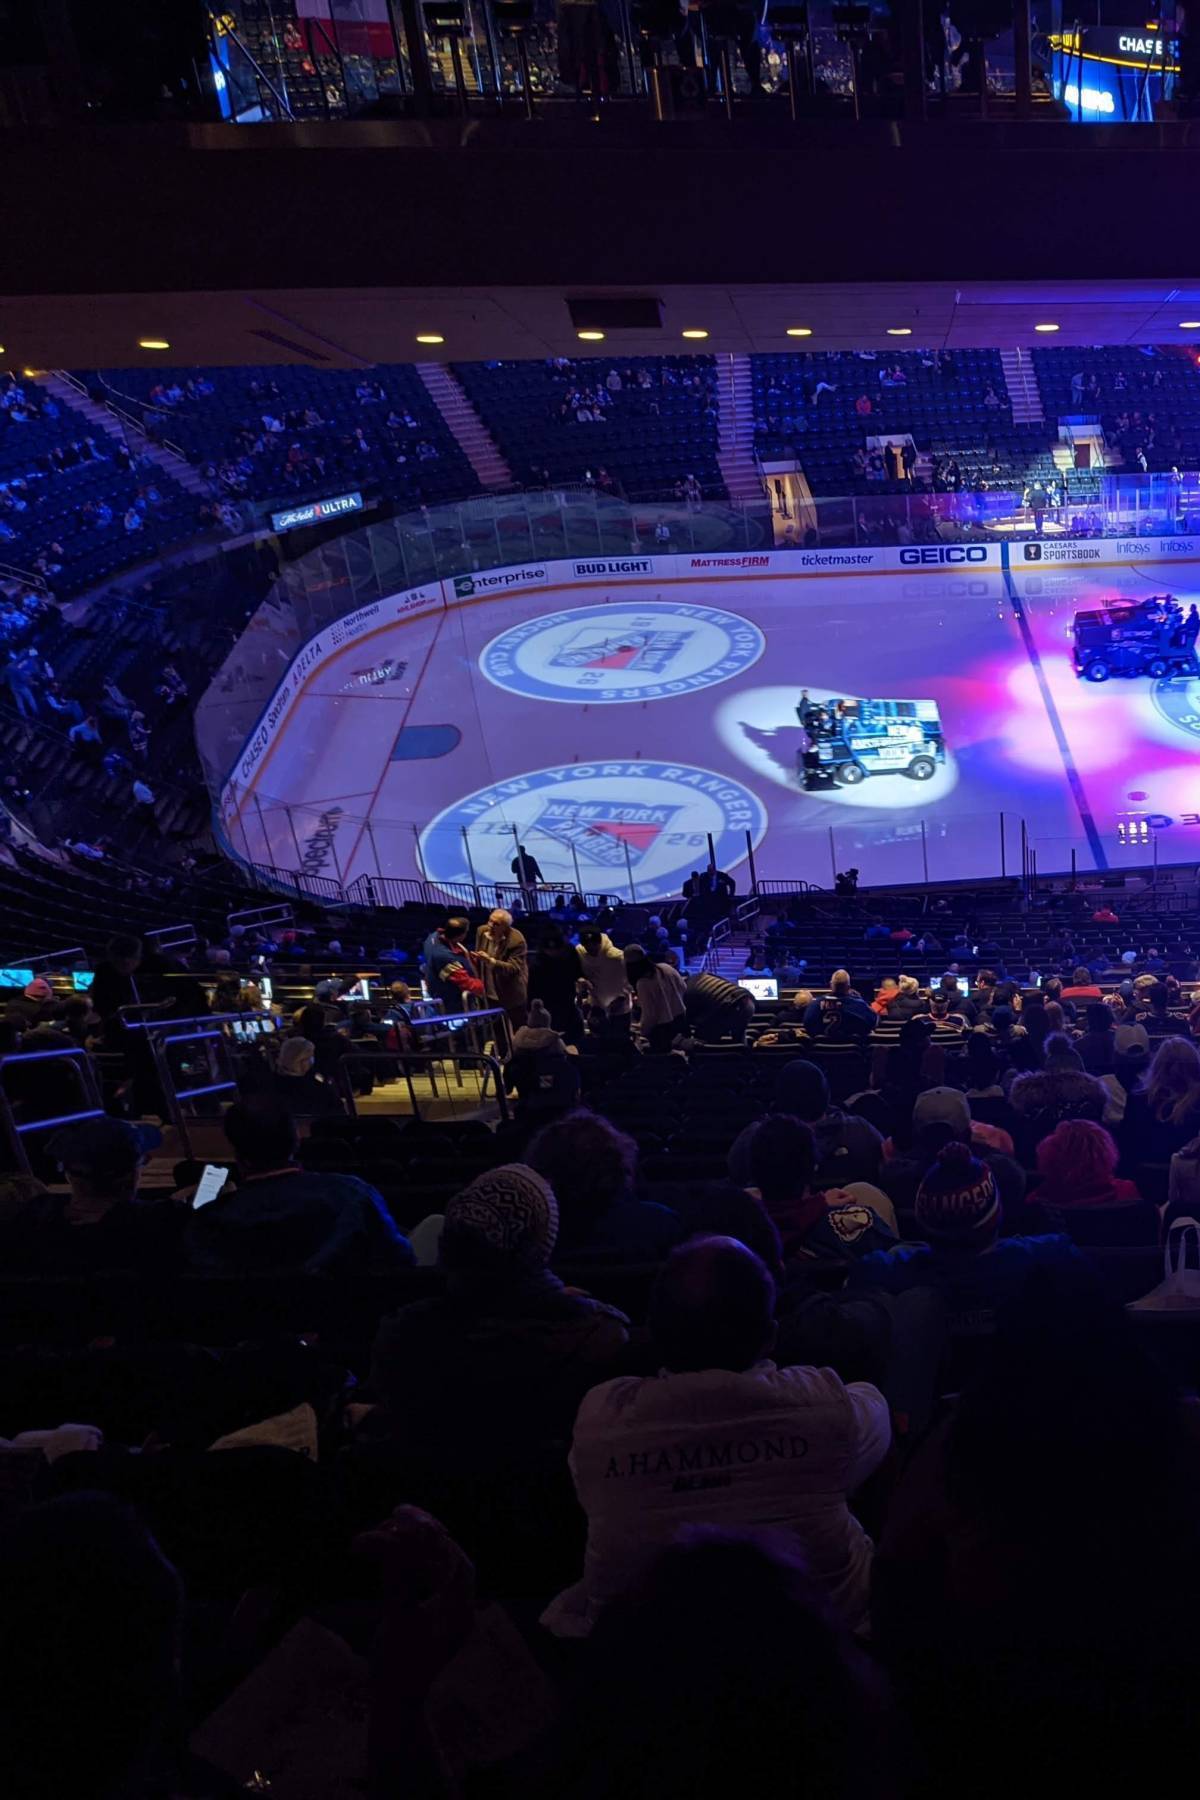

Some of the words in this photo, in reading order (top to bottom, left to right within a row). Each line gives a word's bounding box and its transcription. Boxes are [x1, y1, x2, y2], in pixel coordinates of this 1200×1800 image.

[321, 497, 357, 514] ULTRA
[899, 545, 987, 566] GEICO
[1043, 542, 1078, 550] CAESARS
[1043, 549, 1101, 561] SPORTSBOOK
[1116, 541, 1150, 556] Infosys
[1160, 539, 1194, 554] Infosys
[576, 562, 607, 575] BUD
[608, 561, 649, 575] LIGHT
[801, 552, 874, 567] ticketmaster
[456, 567, 545, 593] enterprise
[674, 606, 736, 627] NEW
[496, 614, 572, 653] HOCKEY
[730, 625, 752, 659] YORK
[488, 652, 515, 677] CLUB
[601, 660, 742, 699] RANGERS
[459, 778, 531, 817] NEW
[549, 763, 649, 782] YORK
[660, 767, 753, 833] RANGERS
[549, 803, 602, 820] NEW
[608, 804, 668, 823] YORK
[552, 819, 637, 866] RANGERS
[664, 832, 707, 848] 26
[604, 1436, 809, 1479] A.HAMMOND
